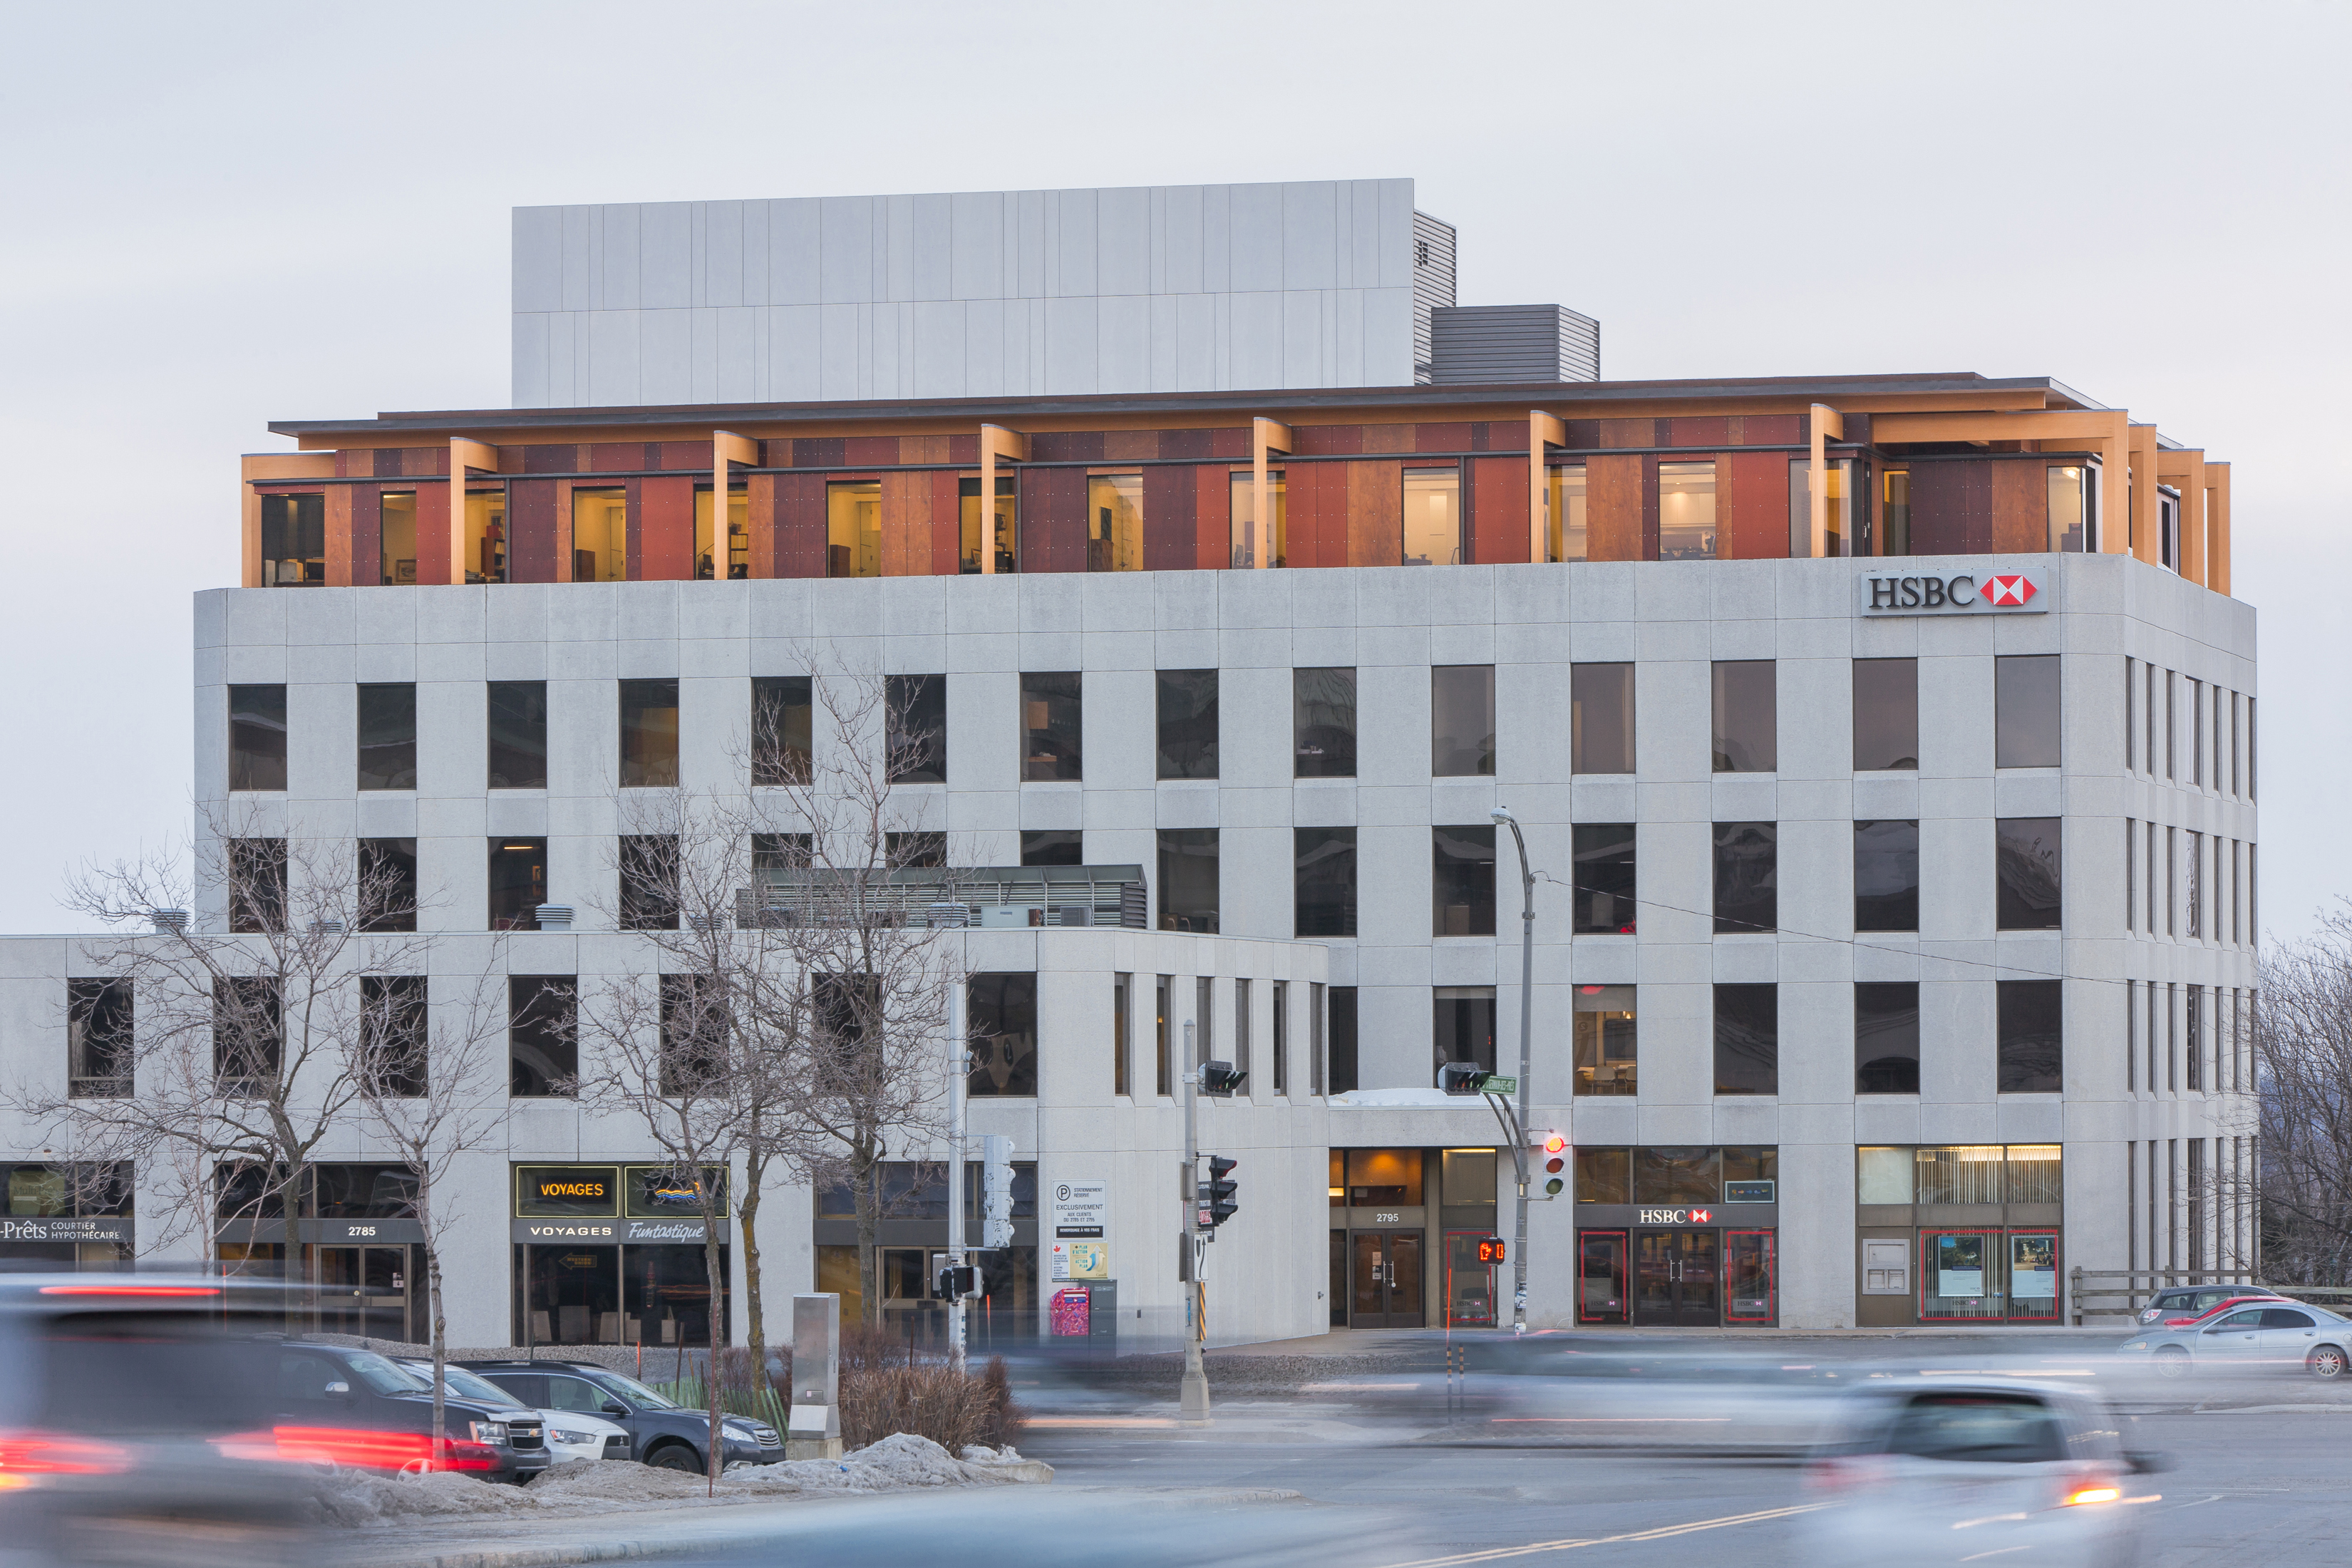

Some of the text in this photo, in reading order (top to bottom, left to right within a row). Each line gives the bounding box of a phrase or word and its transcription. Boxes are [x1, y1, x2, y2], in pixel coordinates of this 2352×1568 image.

[1868, 575, 1975, 608] HSBC
[541, 1184, 604, 1195] VOYAGES
[1376, 1213, 1399, 1222] 2795
[1639, 1209, 1686, 1224] HSBC
[51, 1222, 96, 1230] COURTIER
[51, 1230, 120, 1239] HYPOTHÉCAIRE
[348, 1227, 376, 1236] 2785
[530, 1222, 704, 1242] VOYAGES Funtastique
